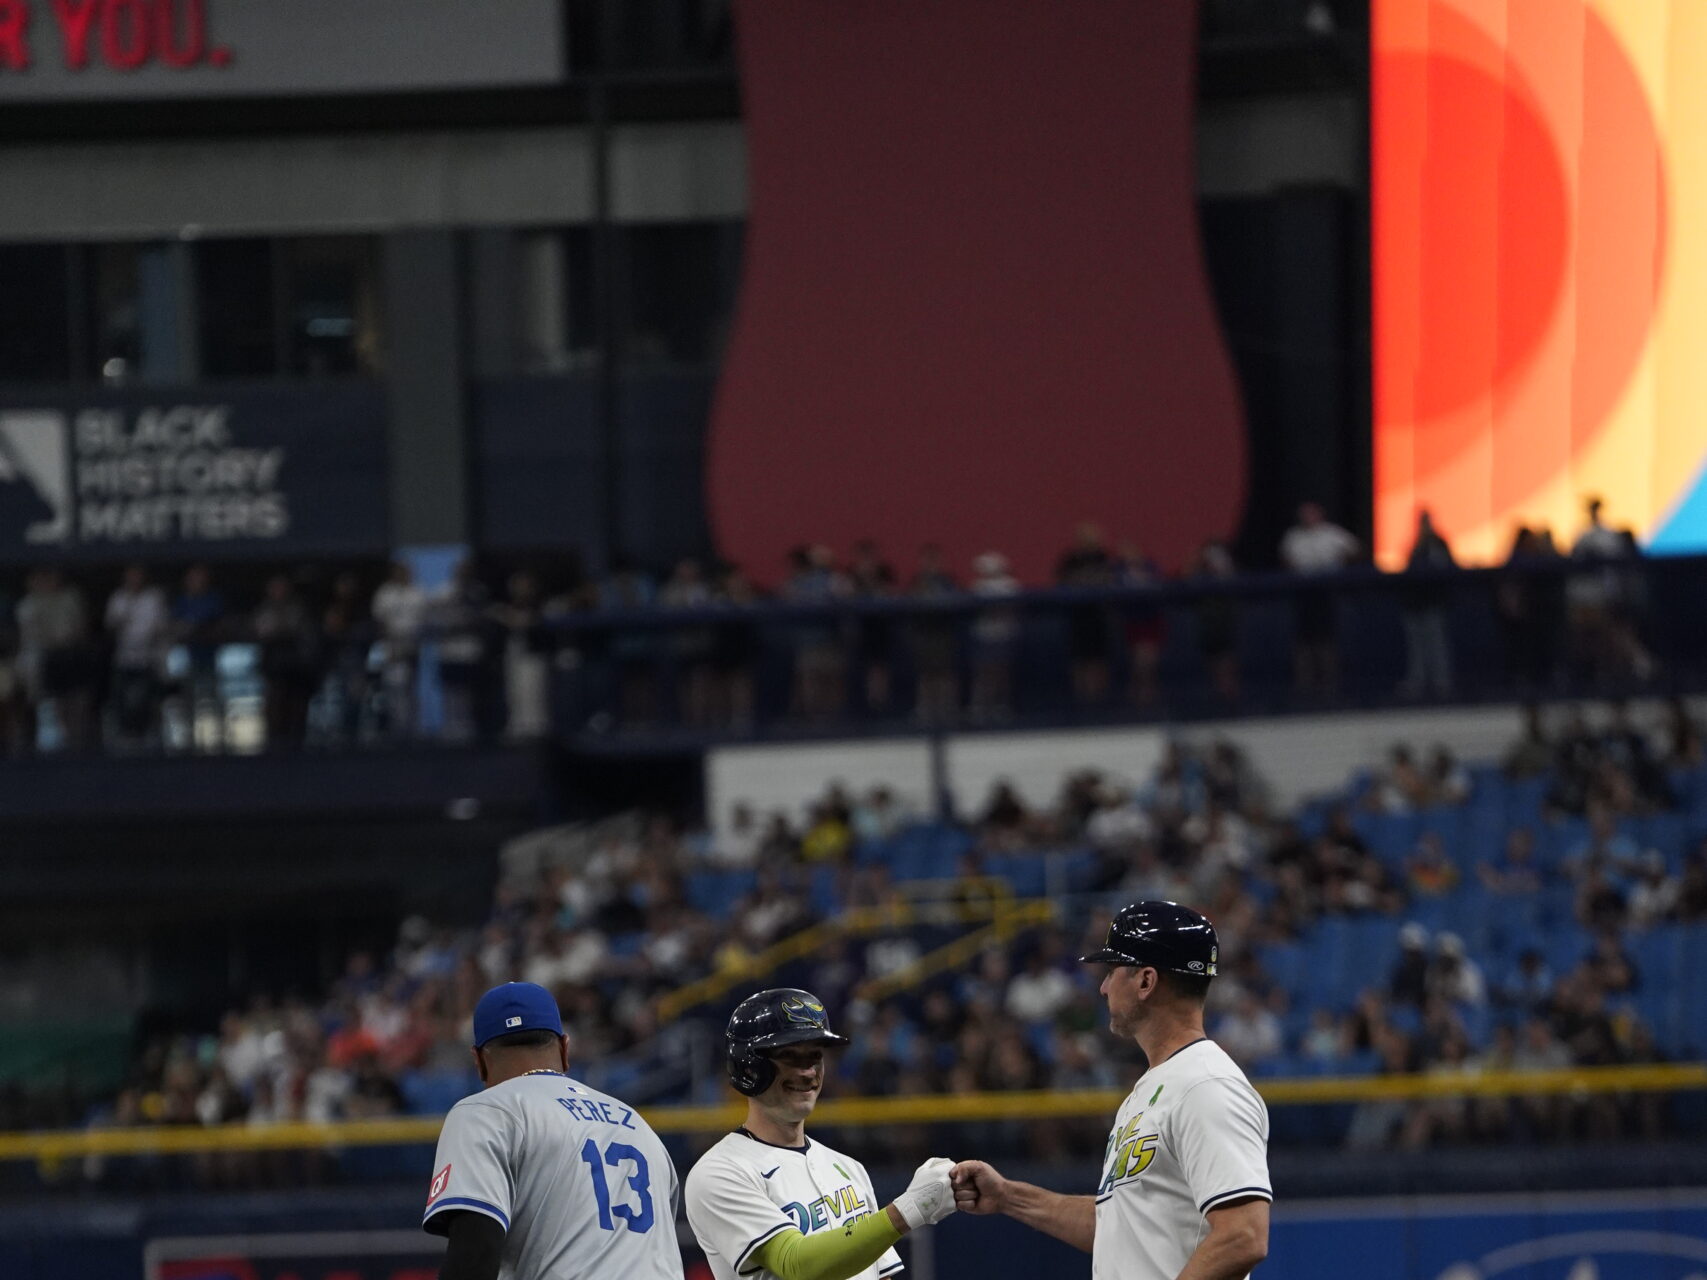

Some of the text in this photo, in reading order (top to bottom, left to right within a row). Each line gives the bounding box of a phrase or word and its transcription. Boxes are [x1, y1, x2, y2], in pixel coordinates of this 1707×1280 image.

[76, 405, 231, 447] BLACK
[77, 448, 284, 493] HISTORY
[79, 493, 289, 541] MATTERS
[556, 1097, 636, 1130] PEREZ
[581, 1138, 655, 1234] 13
[781, 1184, 866, 1236] DEVIL
